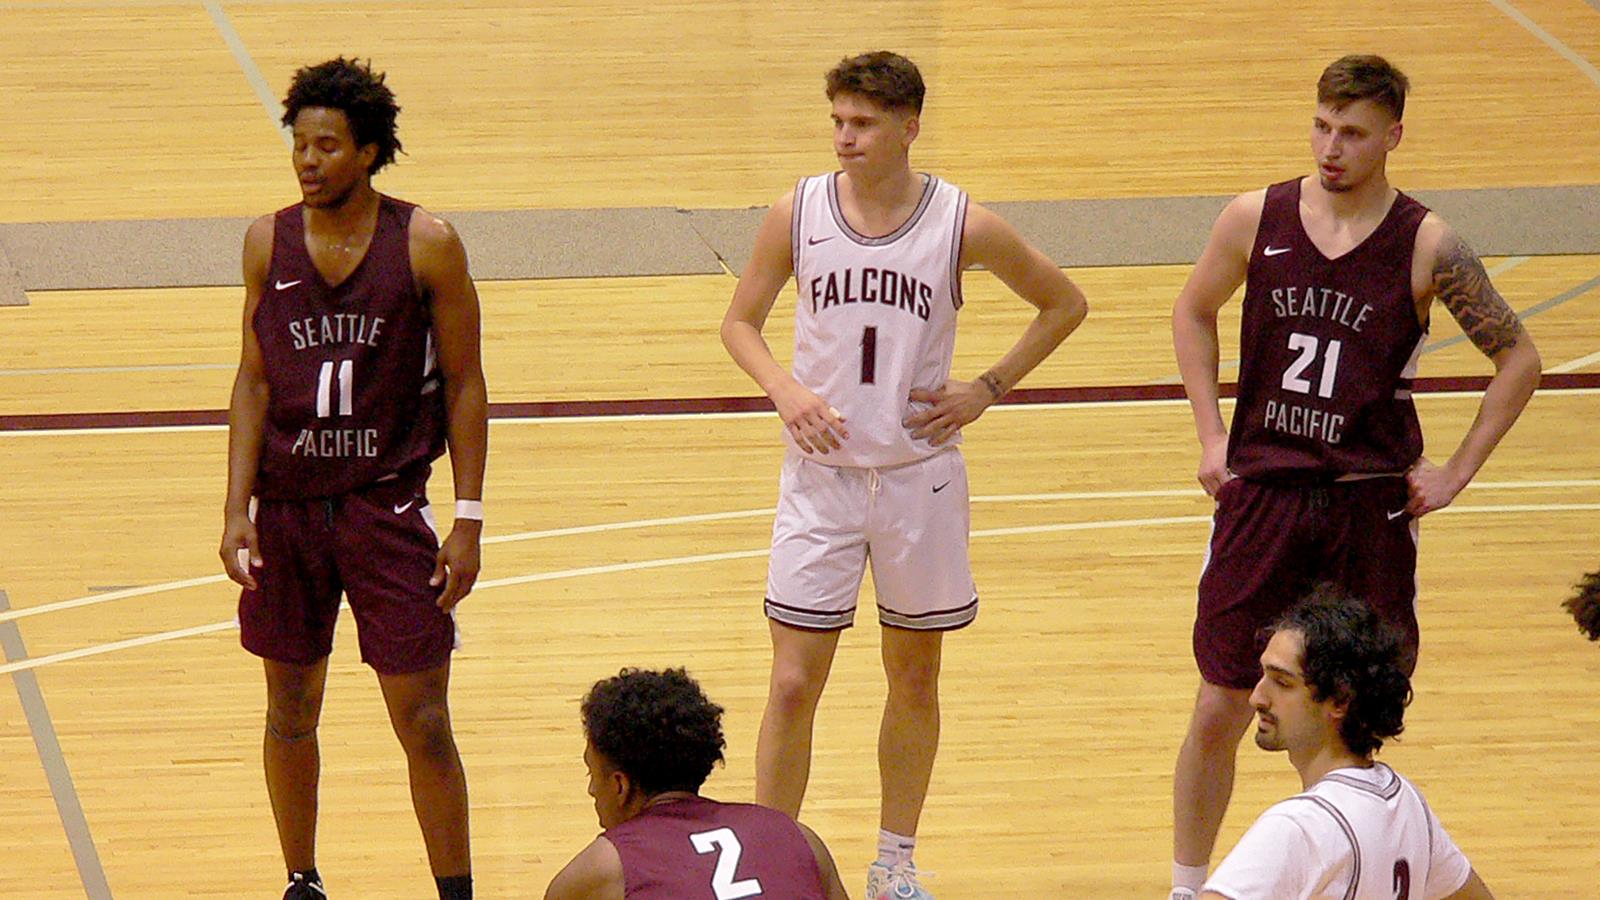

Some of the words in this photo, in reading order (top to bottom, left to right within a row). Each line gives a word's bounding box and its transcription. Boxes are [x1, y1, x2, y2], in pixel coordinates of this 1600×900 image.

[811, 268, 932, 321] FALCONS
[1272, 287, 1373, 332] SEATTLE
[289, 314, 385, 349] SEATTLE
[860, 325, 877, 385] 1
[317, 360, 353, 417] 11
[1281, 332, 1341, 398] 21
[292, 428, 377, 456] PACIFIC
[1264, 400, 1344, 443] PACIFIC
[690, 827, 763, 900] 2
